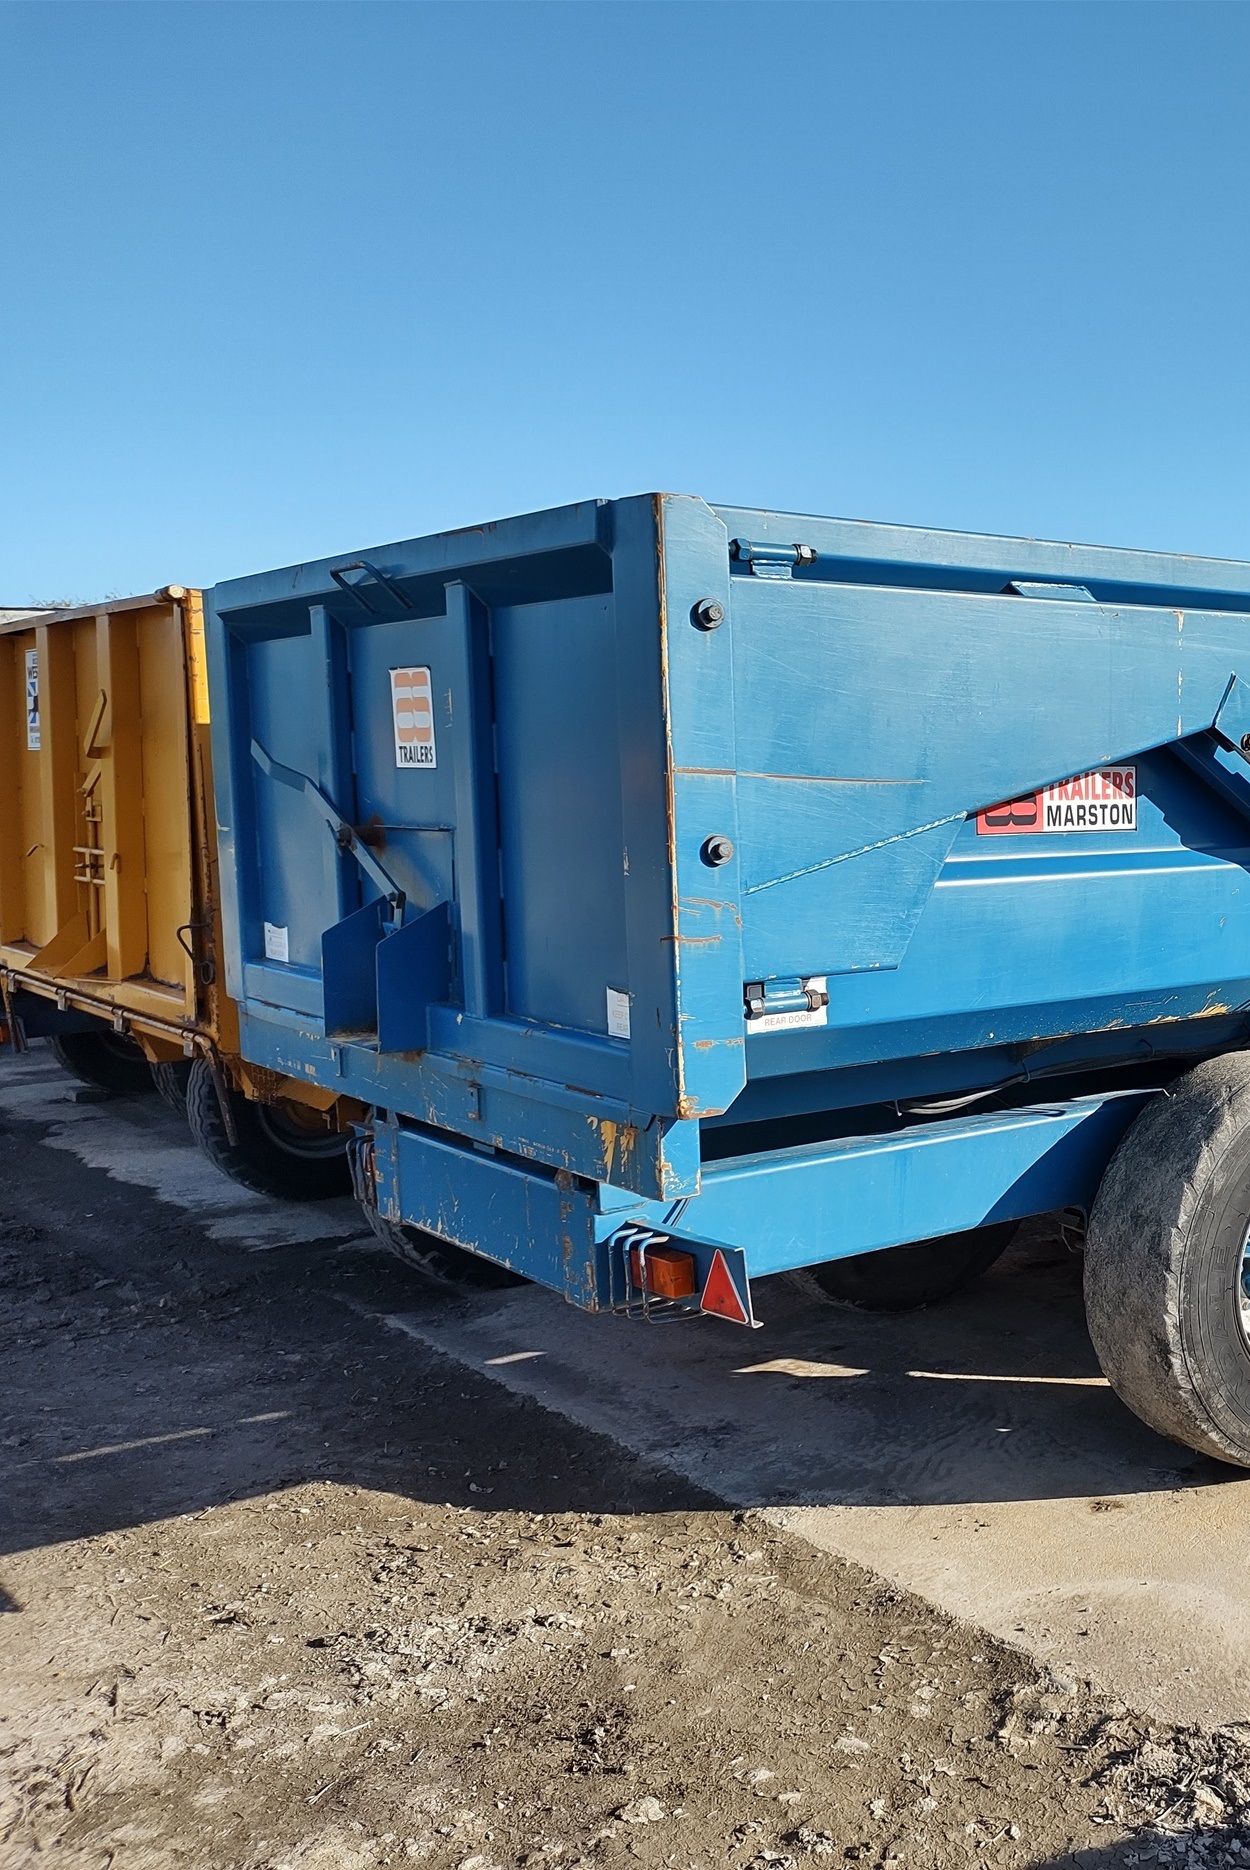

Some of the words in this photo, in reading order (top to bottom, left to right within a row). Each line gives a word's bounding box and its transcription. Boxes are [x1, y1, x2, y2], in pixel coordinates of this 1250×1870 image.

[398, 745, 434, 763] TRAILERS
[1046, 803, 1133, 827] MARSTON
[764, 1016, 787, 1027] REAR
[788, 1013, 812, 1024] DOOR
